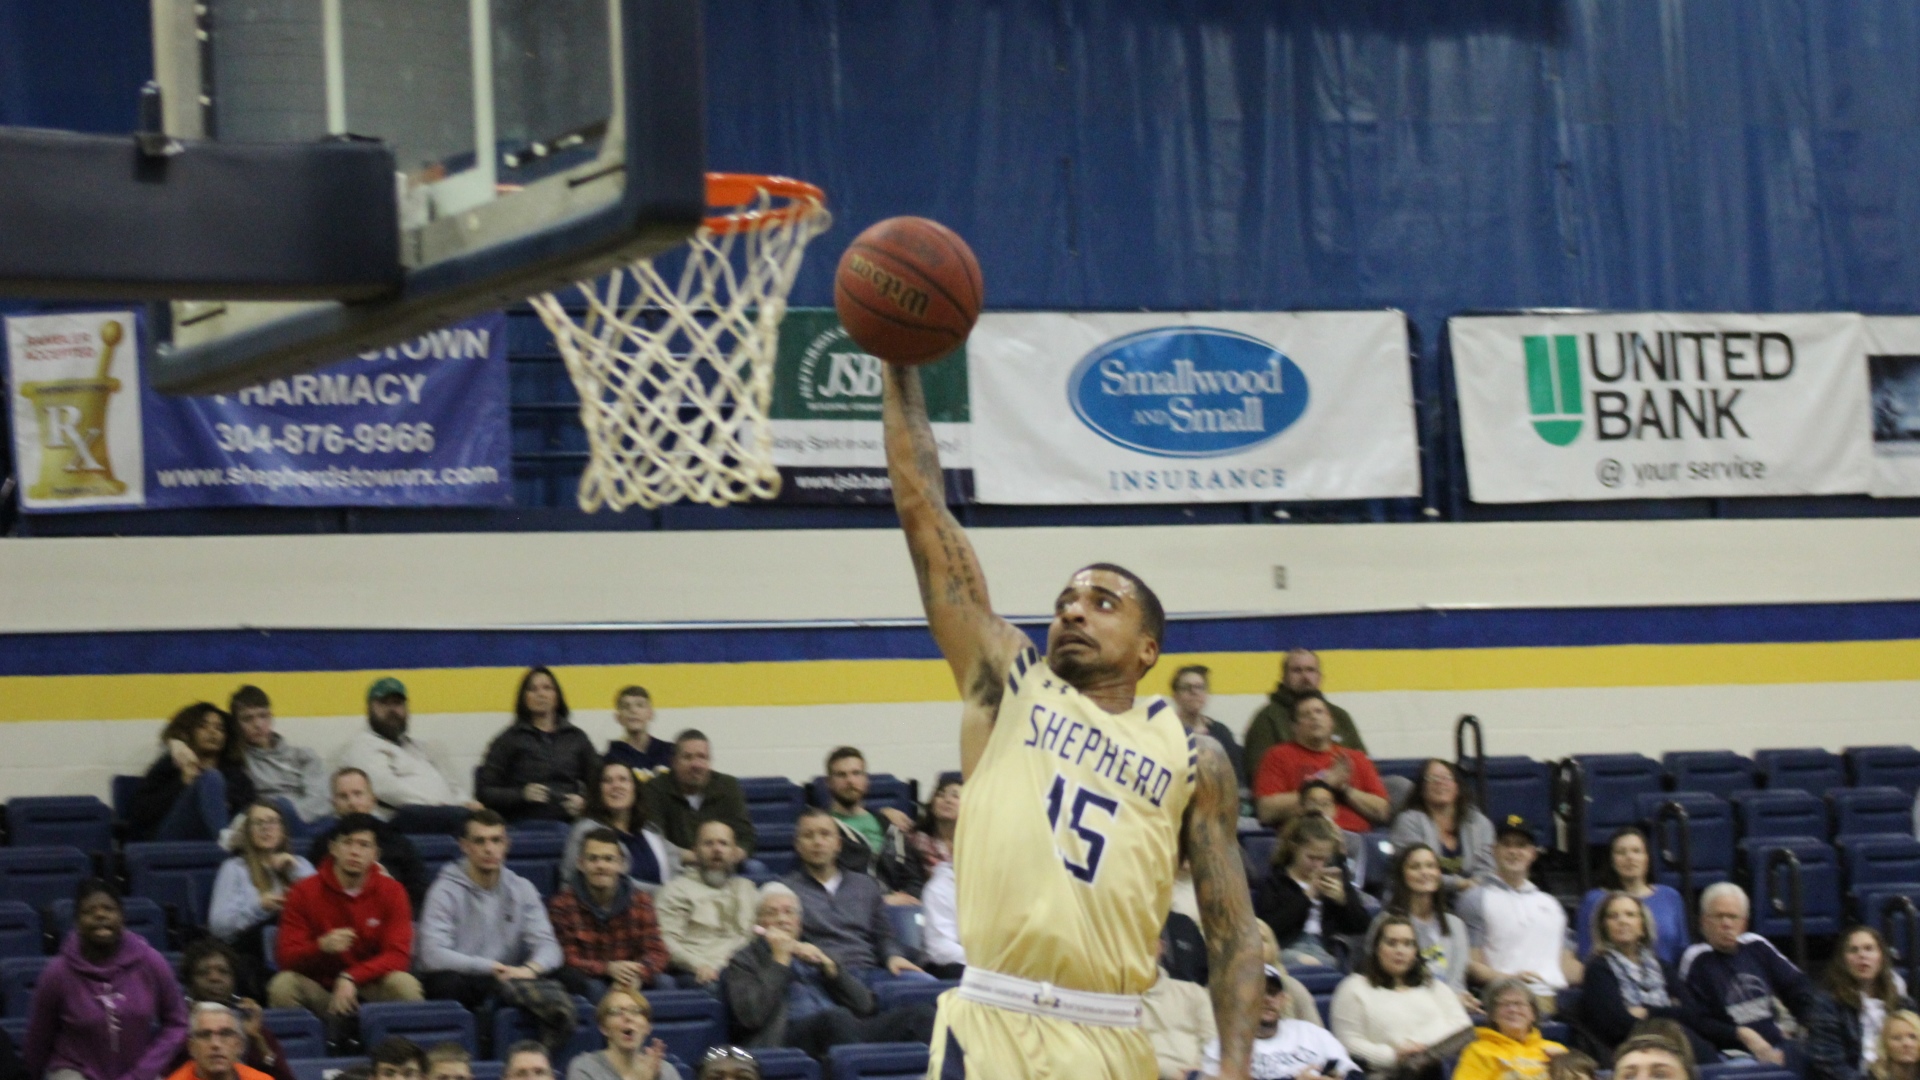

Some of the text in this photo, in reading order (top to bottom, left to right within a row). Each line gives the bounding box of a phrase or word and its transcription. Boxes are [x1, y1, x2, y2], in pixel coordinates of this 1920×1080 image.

[817, 352, 883, 397] JSB
[1587, 332, 1795, 383] UNITED
[213, 373, 427, 406] HARMACY
[1101, 358, 1283, 396] Smallwood
[1168, 396, 1265, 433] Small
[1593, 388, 1750, 441] BANK
[215, 422, 435, 454] 304-876-9966
[1109, 469, 1287, 491] INSURANCE
[1633, 462, 1680, 486] your
[1687, 455, 1767, 480] service
[1024, 704, 1173, 808] SHEPHERD
[1046, 773, 1120, 887] 15
